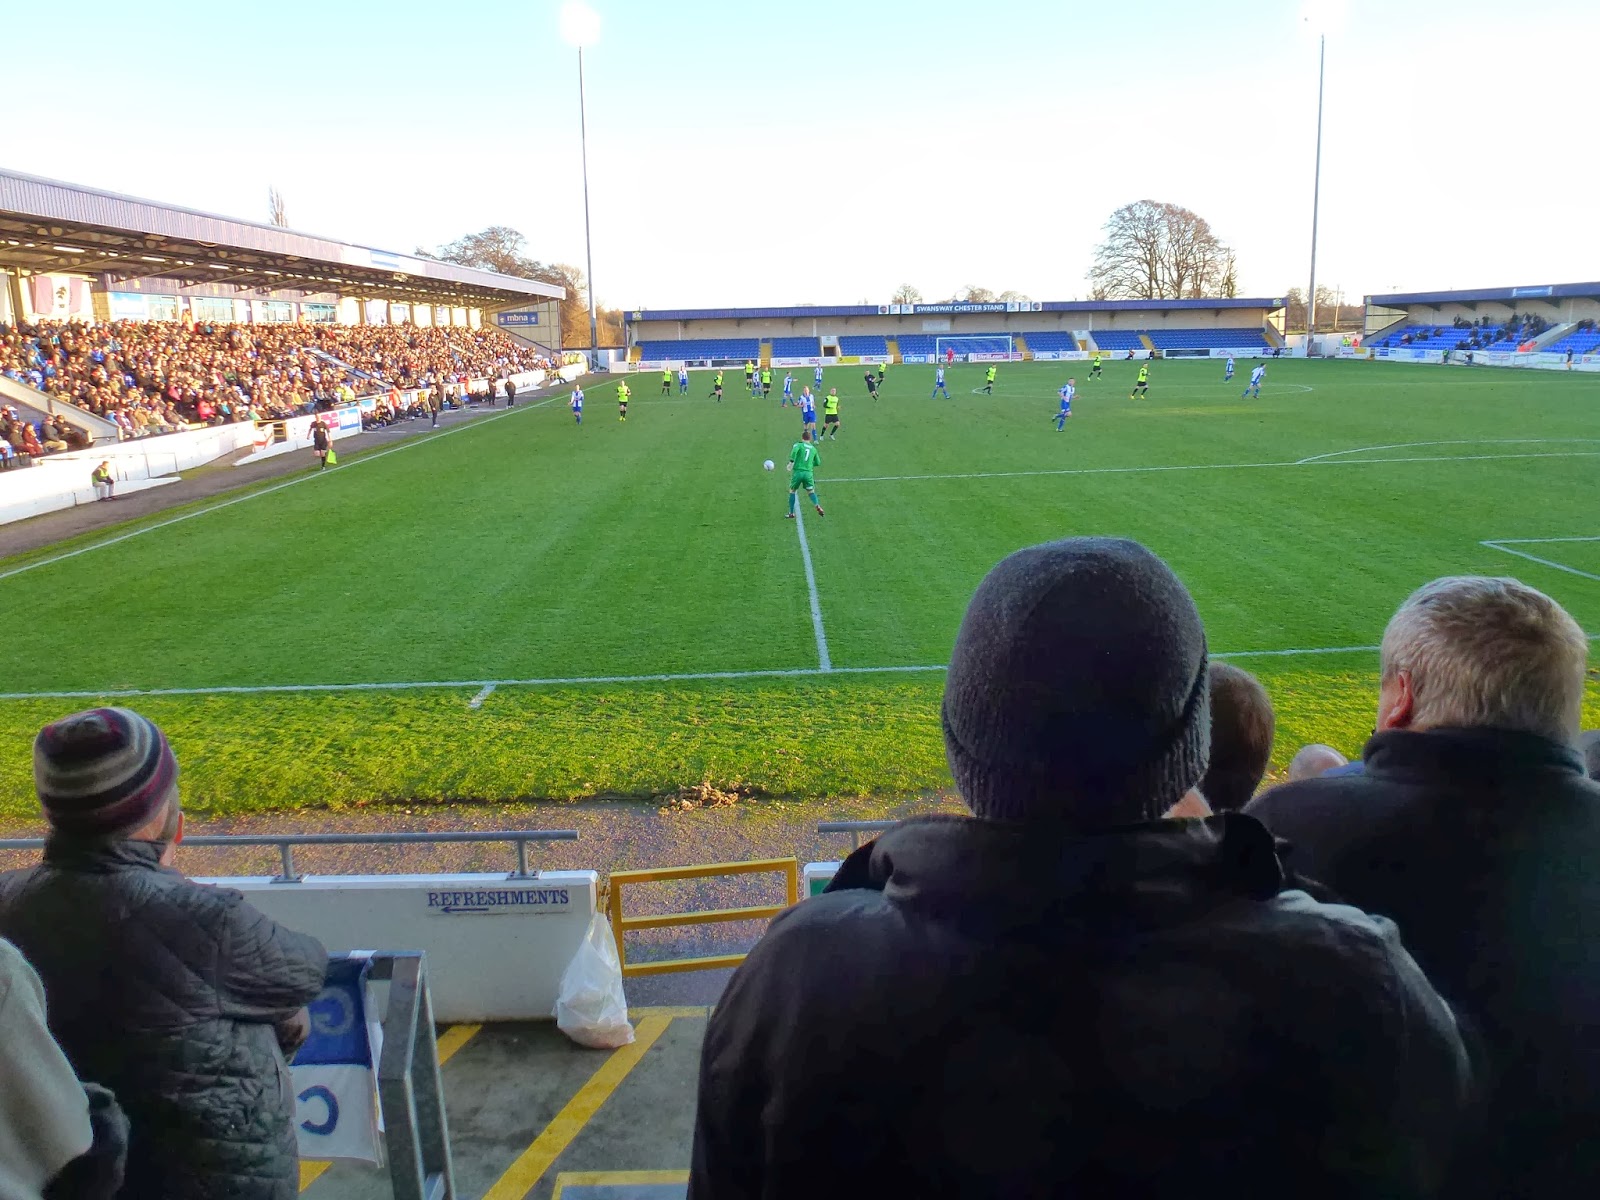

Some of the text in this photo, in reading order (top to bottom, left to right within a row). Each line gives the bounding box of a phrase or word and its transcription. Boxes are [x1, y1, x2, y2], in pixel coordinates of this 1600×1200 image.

[507, 314, 528, 322] mbna
[905, 355, 925, 363] mbna
[427, 889, 569, 907] REFRESHMENTS
